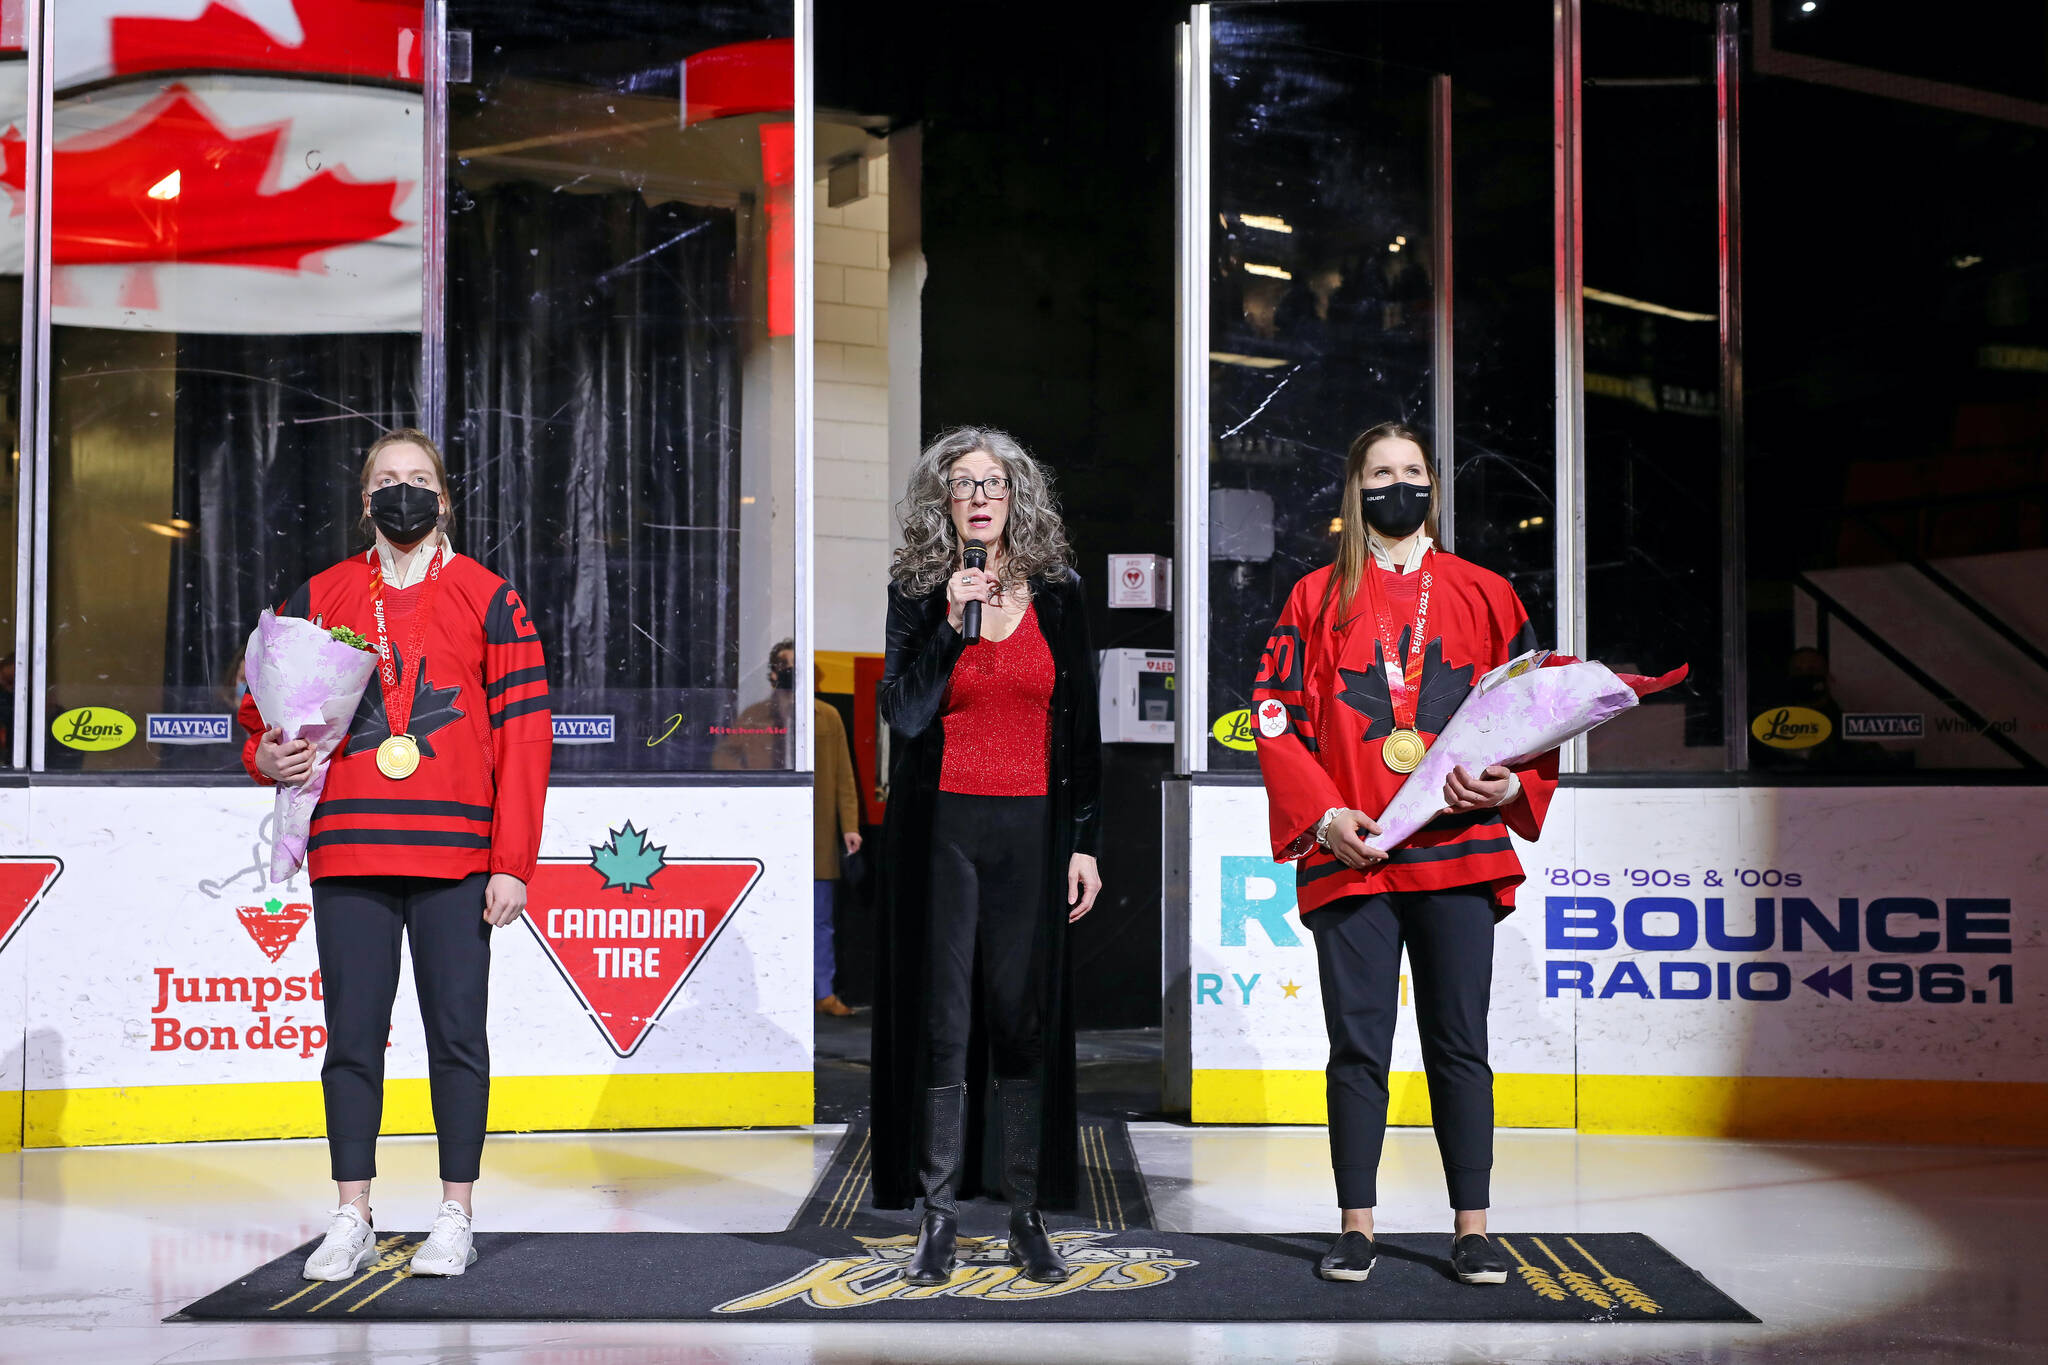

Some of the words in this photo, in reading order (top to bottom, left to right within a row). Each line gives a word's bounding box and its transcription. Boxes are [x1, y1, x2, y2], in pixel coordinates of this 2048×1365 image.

[374, 599, 387, 633] BEIJING
[1418, 590, 1430, 616] 2022
[379, 635, 391, 662] 2022
[1411, 617, 1427, 654] BEIJING
[1155, 661, 1174, 672] AED
[63, 710, 123, 742] Leon's
[152, 720, 227, 736] MAYTAG
[1762, 709, 1819, 741] Leon's
[1848, 718, 1921, 734] MAYTAG
[1545, 868, 1611, 887] '80s
[1624, 868, 1691, 887] '90s
[1703, 869, 1724, 887] &
[1734, 868, 1803, 887] '00s
[547, 908, 706, 939] CANADIAN
[1545, 896, 2013, 954] BOUNCE
[592, 947, 661, 979] TIRE
[151, 967, 325, 1013] Jumpst
[1545, 960, 1791, 1002] RADIO
[1866, 962, 2014, 1004] 96.1
[150, 1017, 239, 1051] Bon
[246, 1016, 392, 1059] dép
